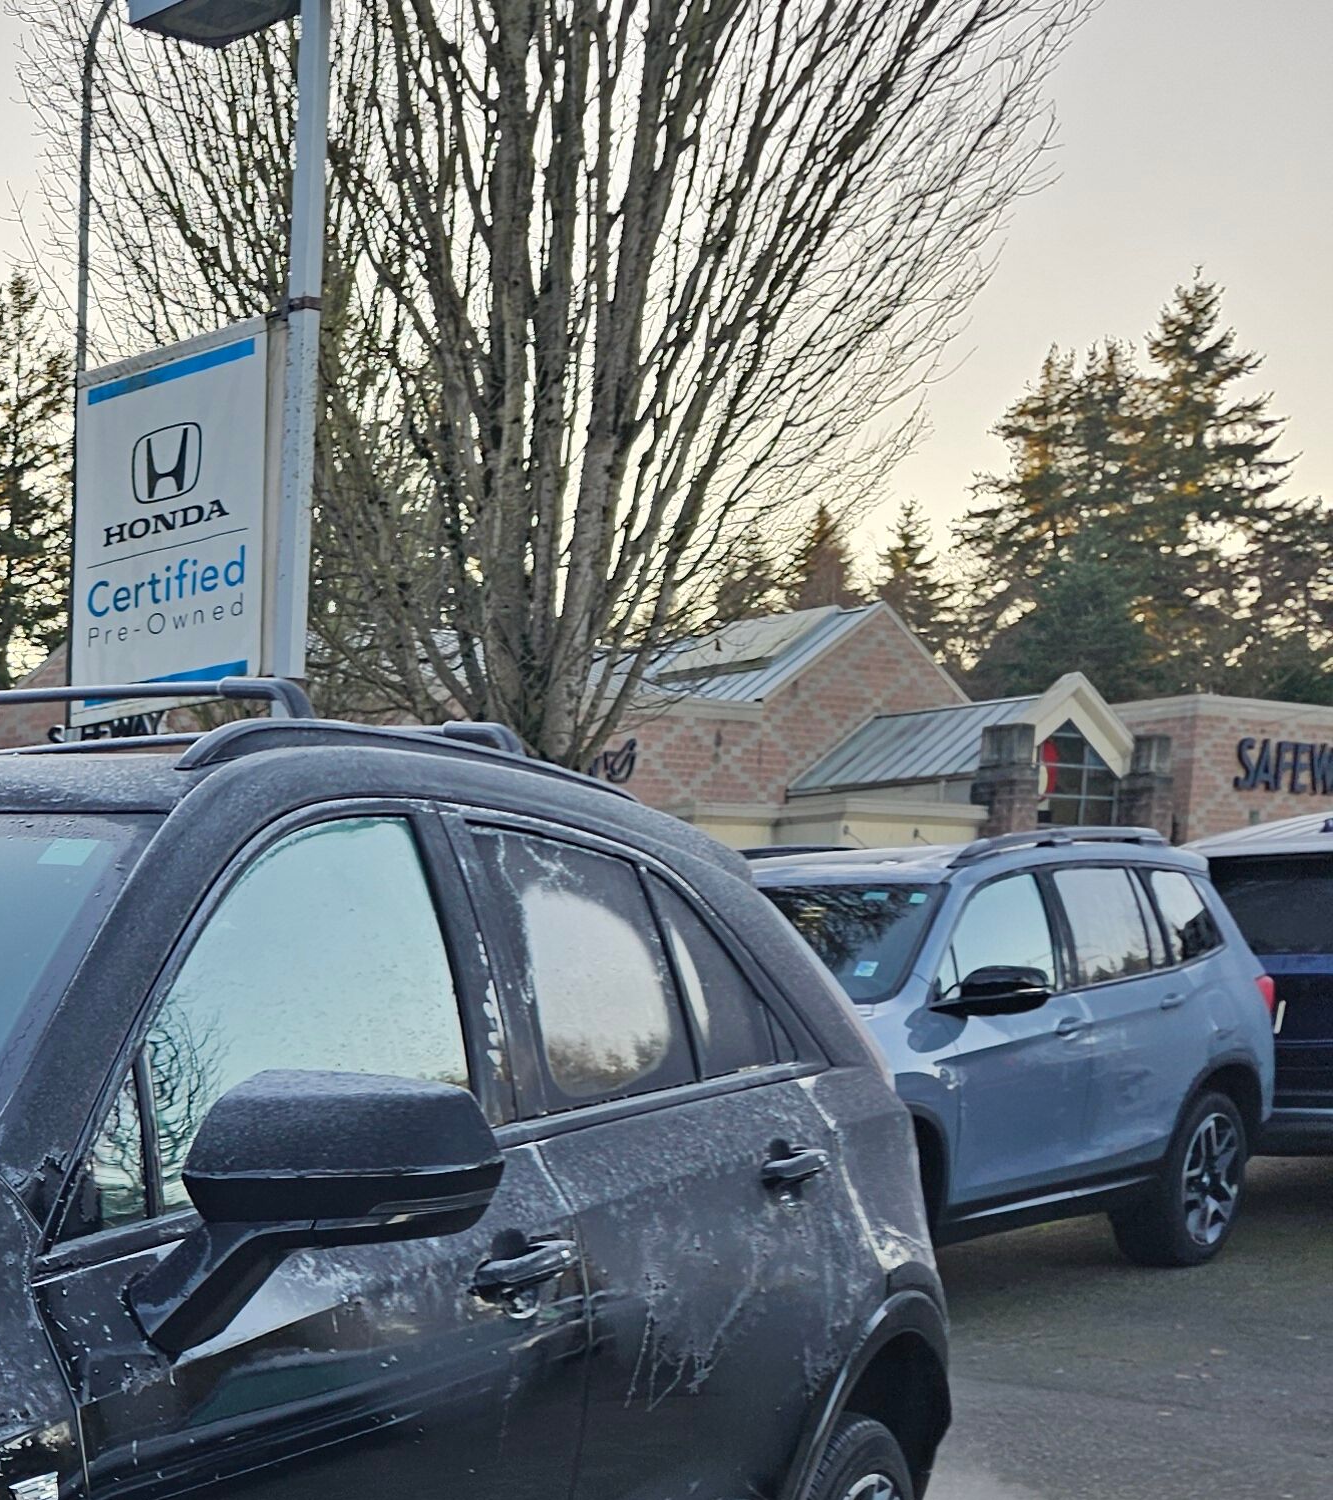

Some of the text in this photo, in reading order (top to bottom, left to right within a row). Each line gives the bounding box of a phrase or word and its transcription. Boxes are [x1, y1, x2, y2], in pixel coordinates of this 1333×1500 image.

[103, 499, 229, 547] HONDA
[88, 544, 245, 617] Certified
[88, 592, 243, 648] Pre-Owned
